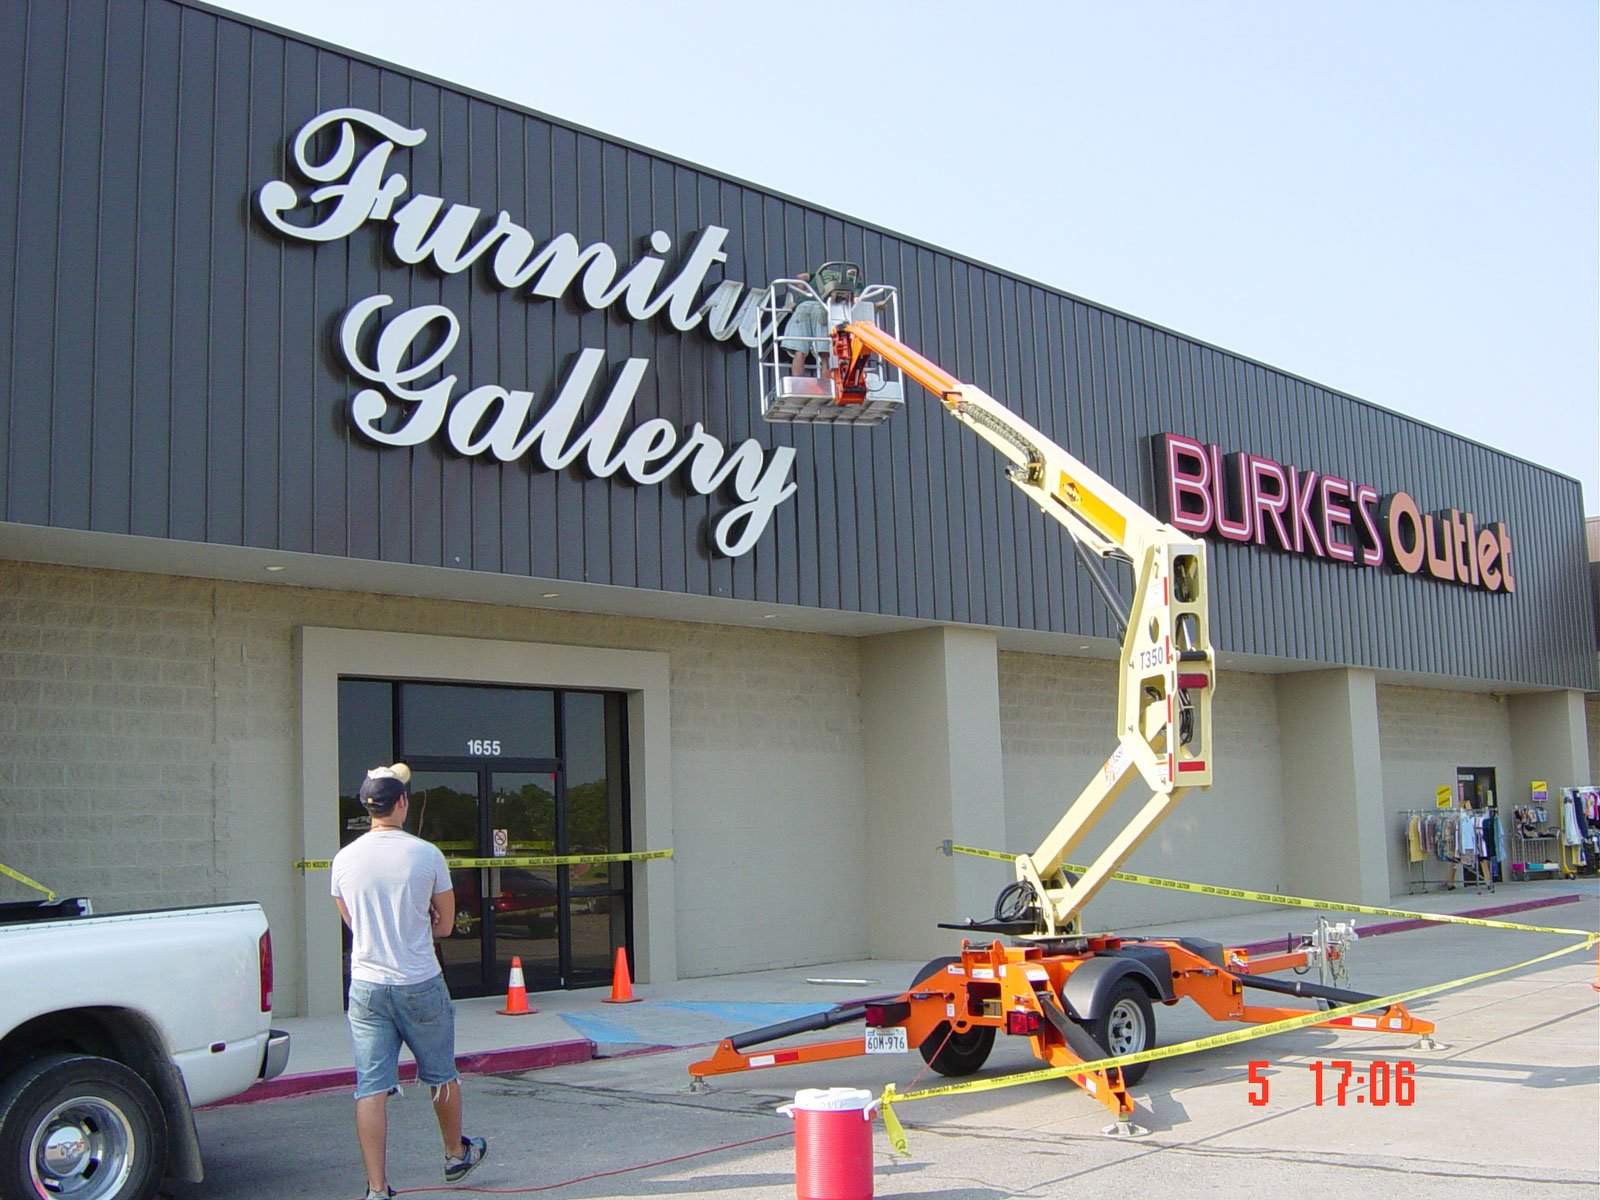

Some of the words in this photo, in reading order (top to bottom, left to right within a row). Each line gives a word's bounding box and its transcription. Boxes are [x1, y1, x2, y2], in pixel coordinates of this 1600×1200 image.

[259, 108, 796, 348] Furnitu
[339, 294, 797, 557] Gallery
[1165, 432, 1383, 566] BURKE'S
[1388, 491, 1514, 593] Outlet
[1140, 646, 1163, 670] T350
[467, 739, 501, 755] 1655
